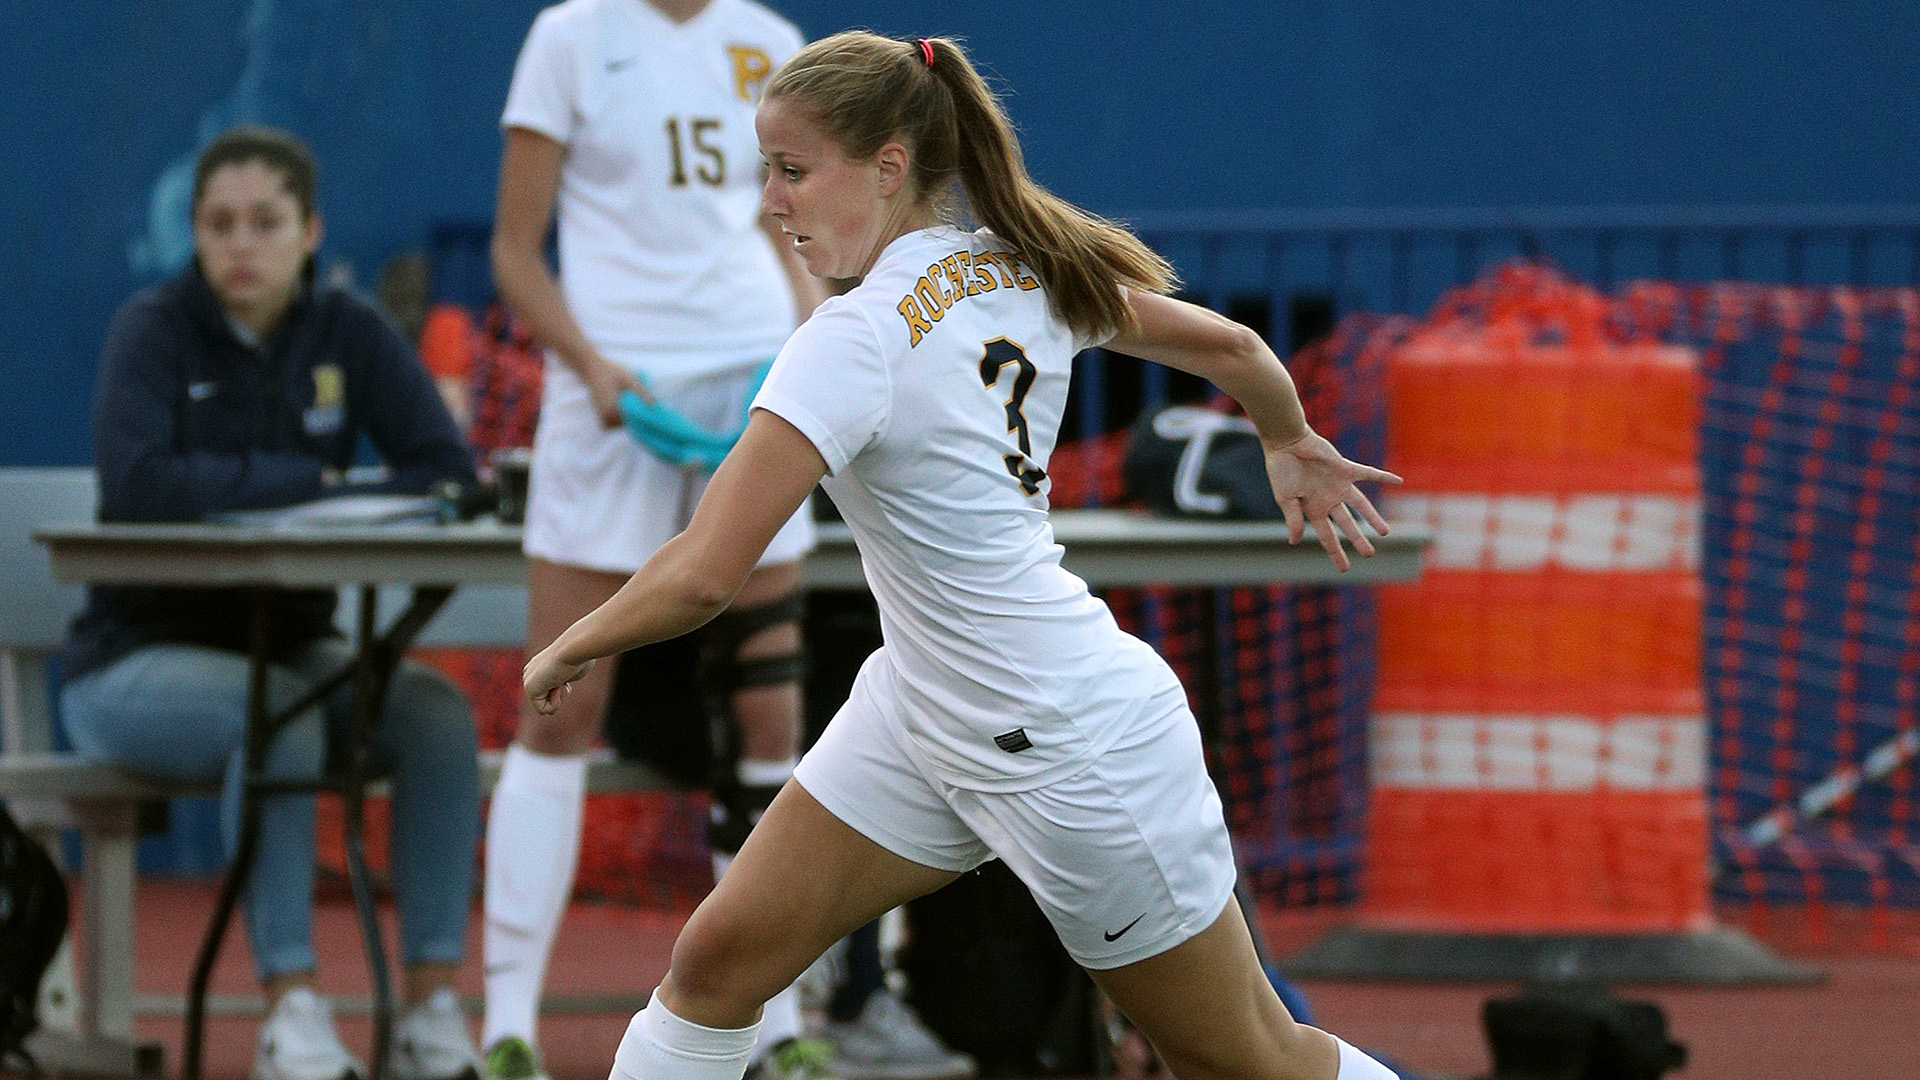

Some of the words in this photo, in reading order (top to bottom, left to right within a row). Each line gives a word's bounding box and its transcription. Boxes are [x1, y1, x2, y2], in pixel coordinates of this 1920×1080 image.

[666, 117, 725, 186] 15
[897, 250, 1040, 348] ROCHESTE
[979, 335, 1047, 497] 3
